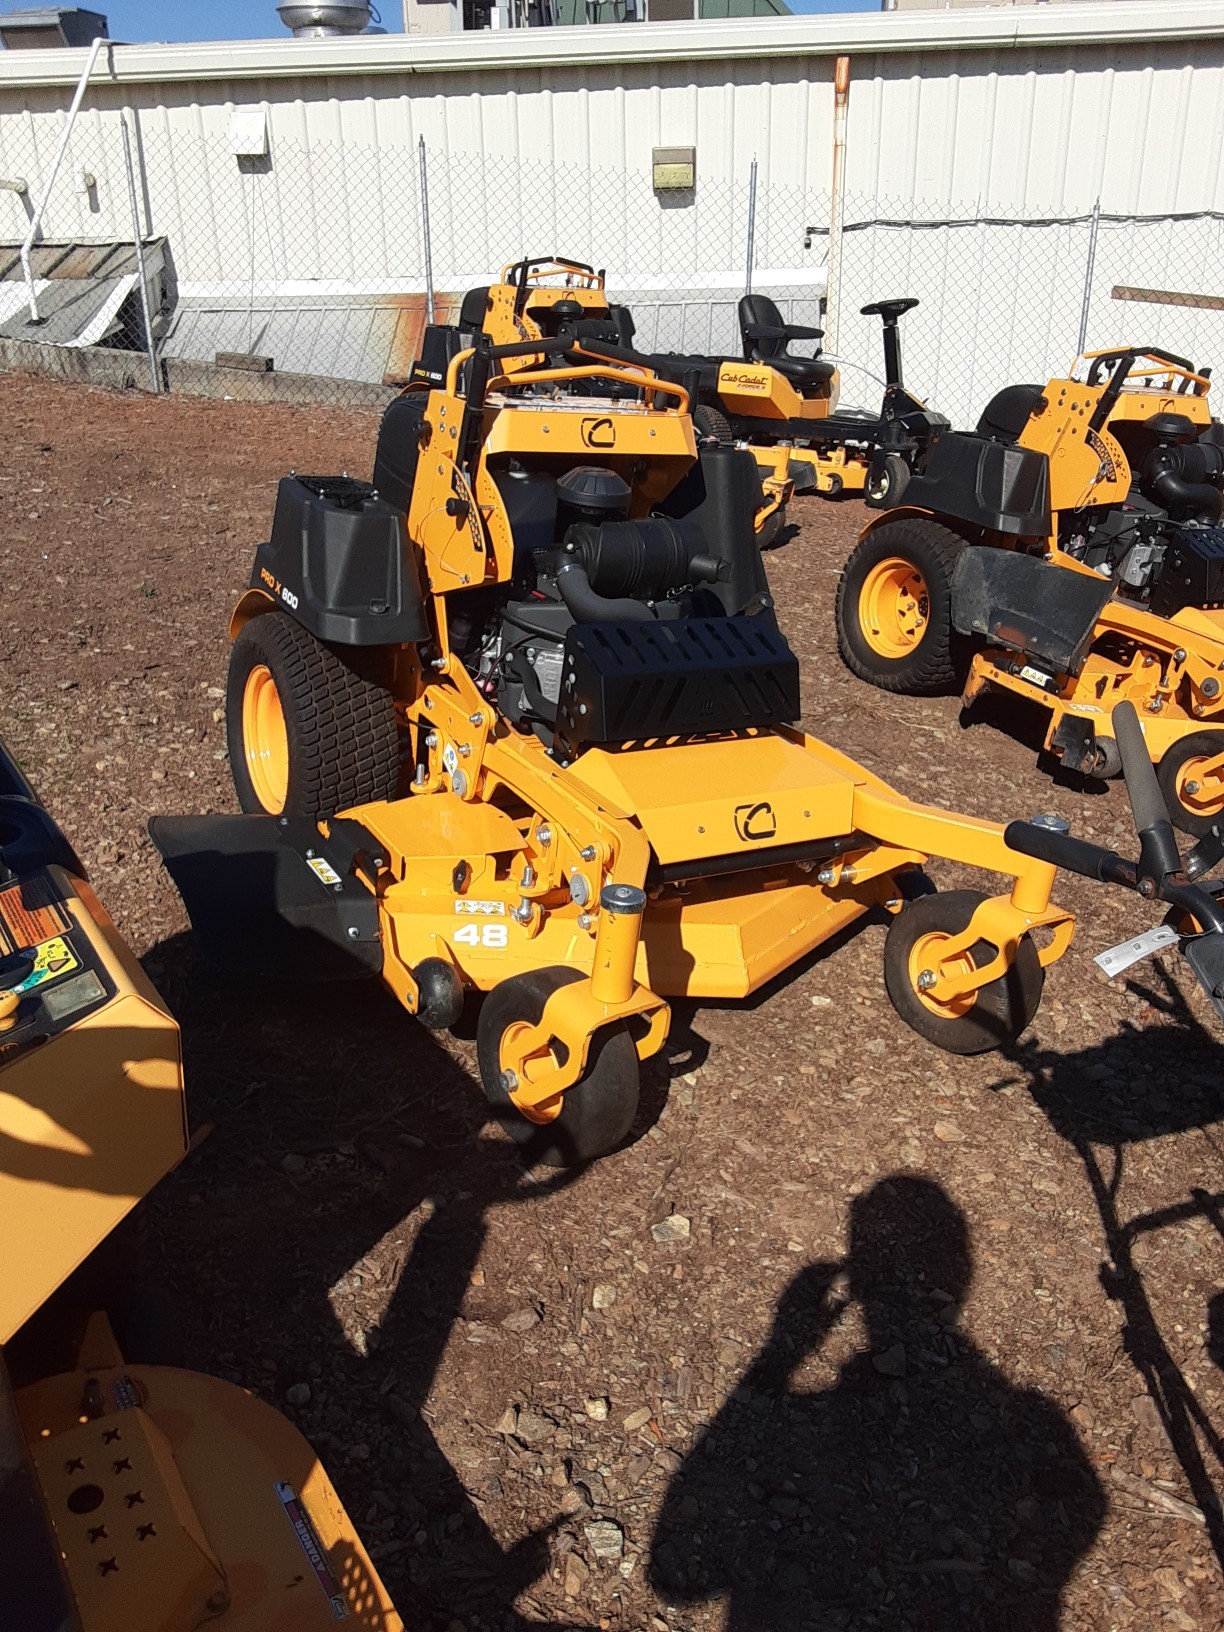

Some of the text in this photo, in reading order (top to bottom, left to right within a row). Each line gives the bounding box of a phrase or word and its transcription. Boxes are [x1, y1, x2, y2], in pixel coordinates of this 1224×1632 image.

[430, 372, 443, 381] 600
[720, 373, 767, 385] Cub Cadet
[261, 567, 299, 609] PRO X 600
[454, 923, 508, 947] 48
[294, 1519, 320, 1564] DANGER
